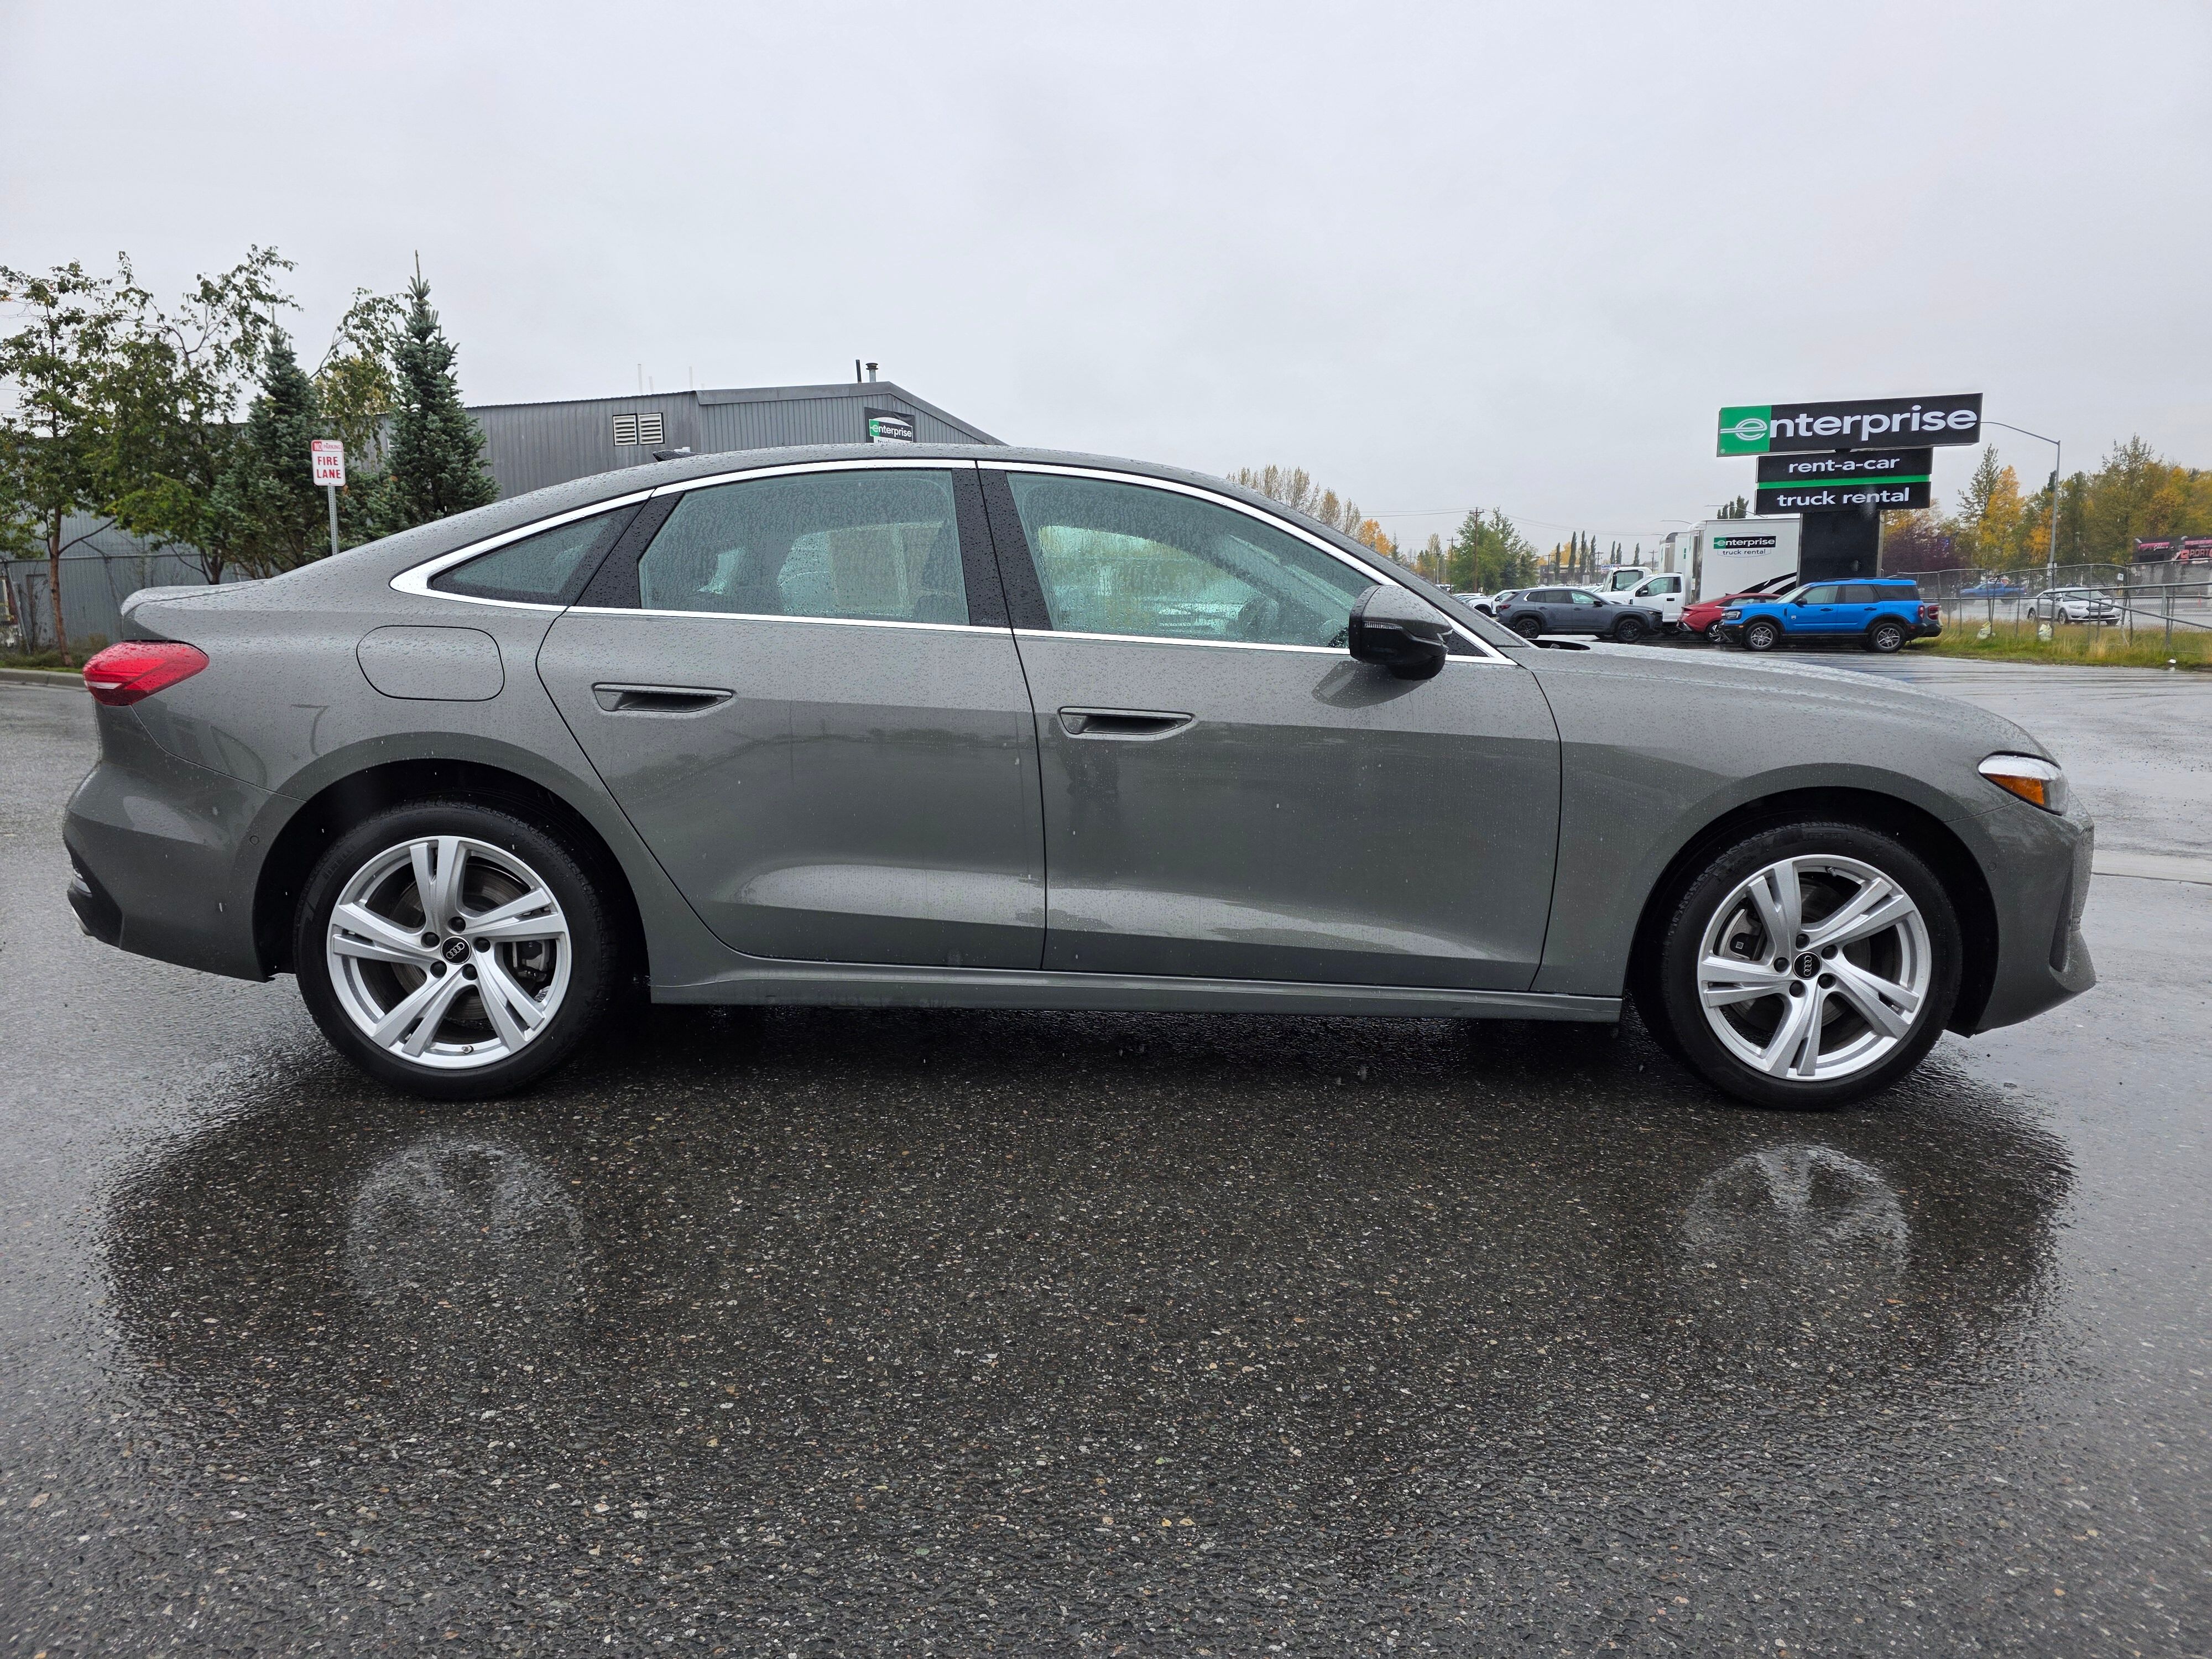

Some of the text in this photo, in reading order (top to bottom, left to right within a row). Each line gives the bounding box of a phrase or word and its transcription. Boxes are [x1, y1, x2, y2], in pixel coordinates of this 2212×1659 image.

[1720, 405, 1978, 441] enterprise
[870, 424, 912, 437] enterprise
[314, 442, 322, 451] NO
[317, 456, 338, 466] FIRE
[1788, 456, 1900, 473] rent-a-car
[317, 469, 341, 479] LANE
[1777, 487, 1910, 507] truck rental
[1714, 538, 1775, 547] enterprise
